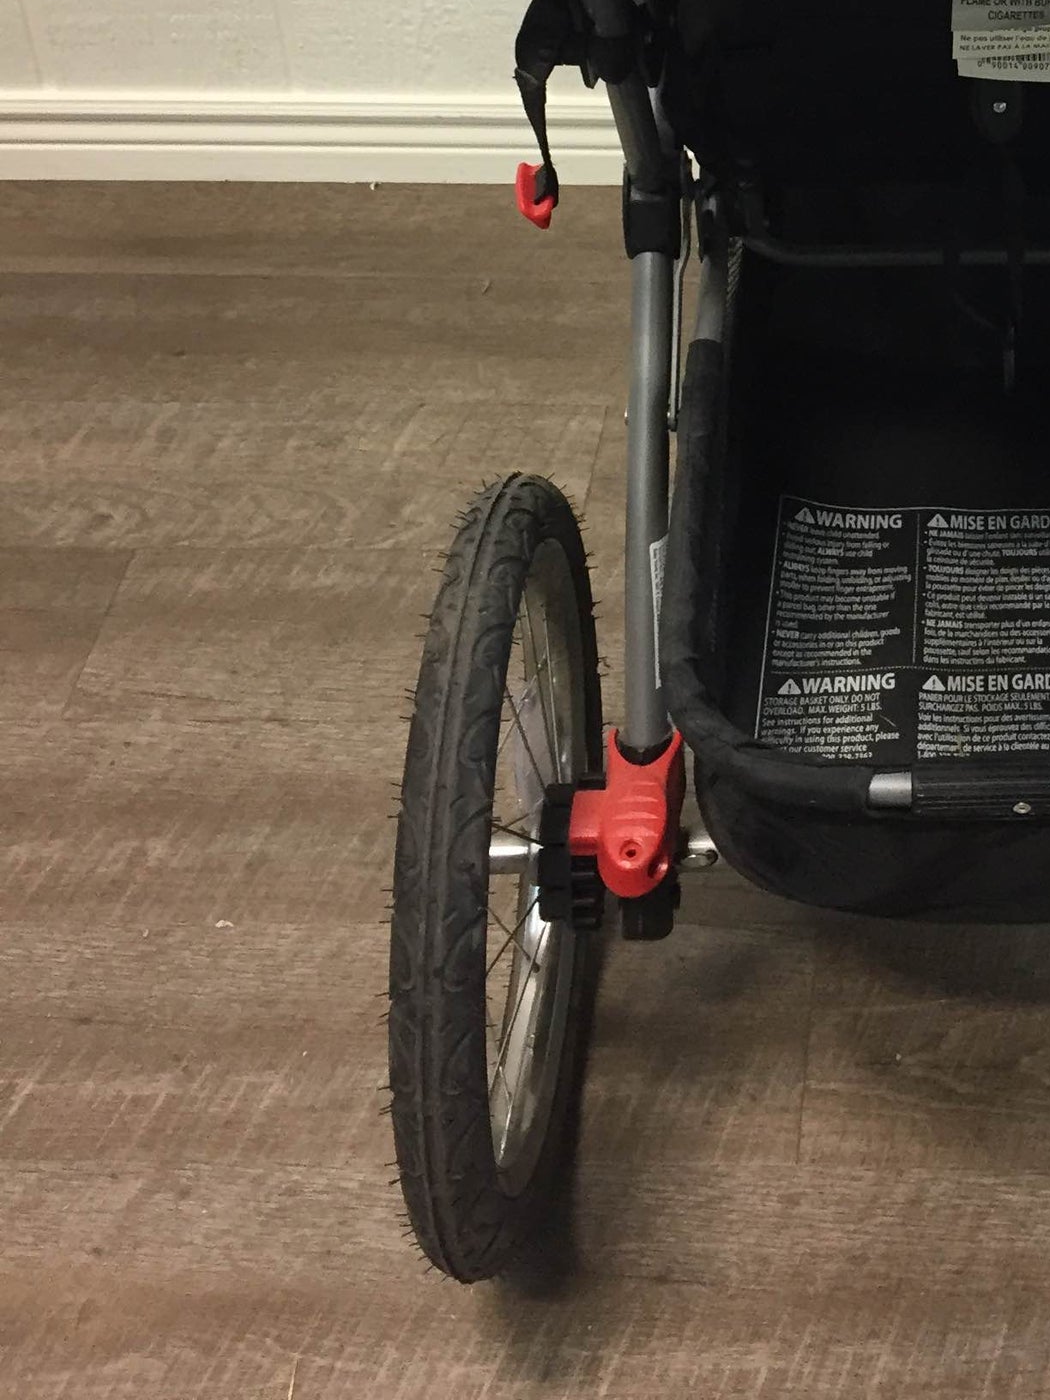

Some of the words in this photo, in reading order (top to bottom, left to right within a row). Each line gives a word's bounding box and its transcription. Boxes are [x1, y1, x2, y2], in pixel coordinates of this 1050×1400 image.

[988, 11, 1045, 21] CIGARETTES
[816, 509, 903, 529] WARNING
[950, 514, 985, 530] MISE
[987, 514, 1007, 530] EN
[802, 673, 896, 694] WARNING
[947, 675, 986, 692] MISE
[988, 674, 1009, 691] EN
[763, 697, 798, 707] STORAGE
[799, 695, 829, 706] BASKET
[851, 694, 863, 703] DO
[864, 692, 881, 702] NOT
[762, 718, 777, 727] See
[777, 716, 822, 726] instructions
[823, 715, 835, 724] for
[835, 714, 874, 724] additional
[807, 726, 822, 736] you
[823, 725, 865, 736] experience
[865, 724, 880, 734] any
[794, 736, 803, 744] in
[804, 735, 826, 745] using
[827, 733, 841, 743] this
[875, 731, 900, 742] please
[803, 744, 839, 753] customer
[840, 743, 868, 753] service
